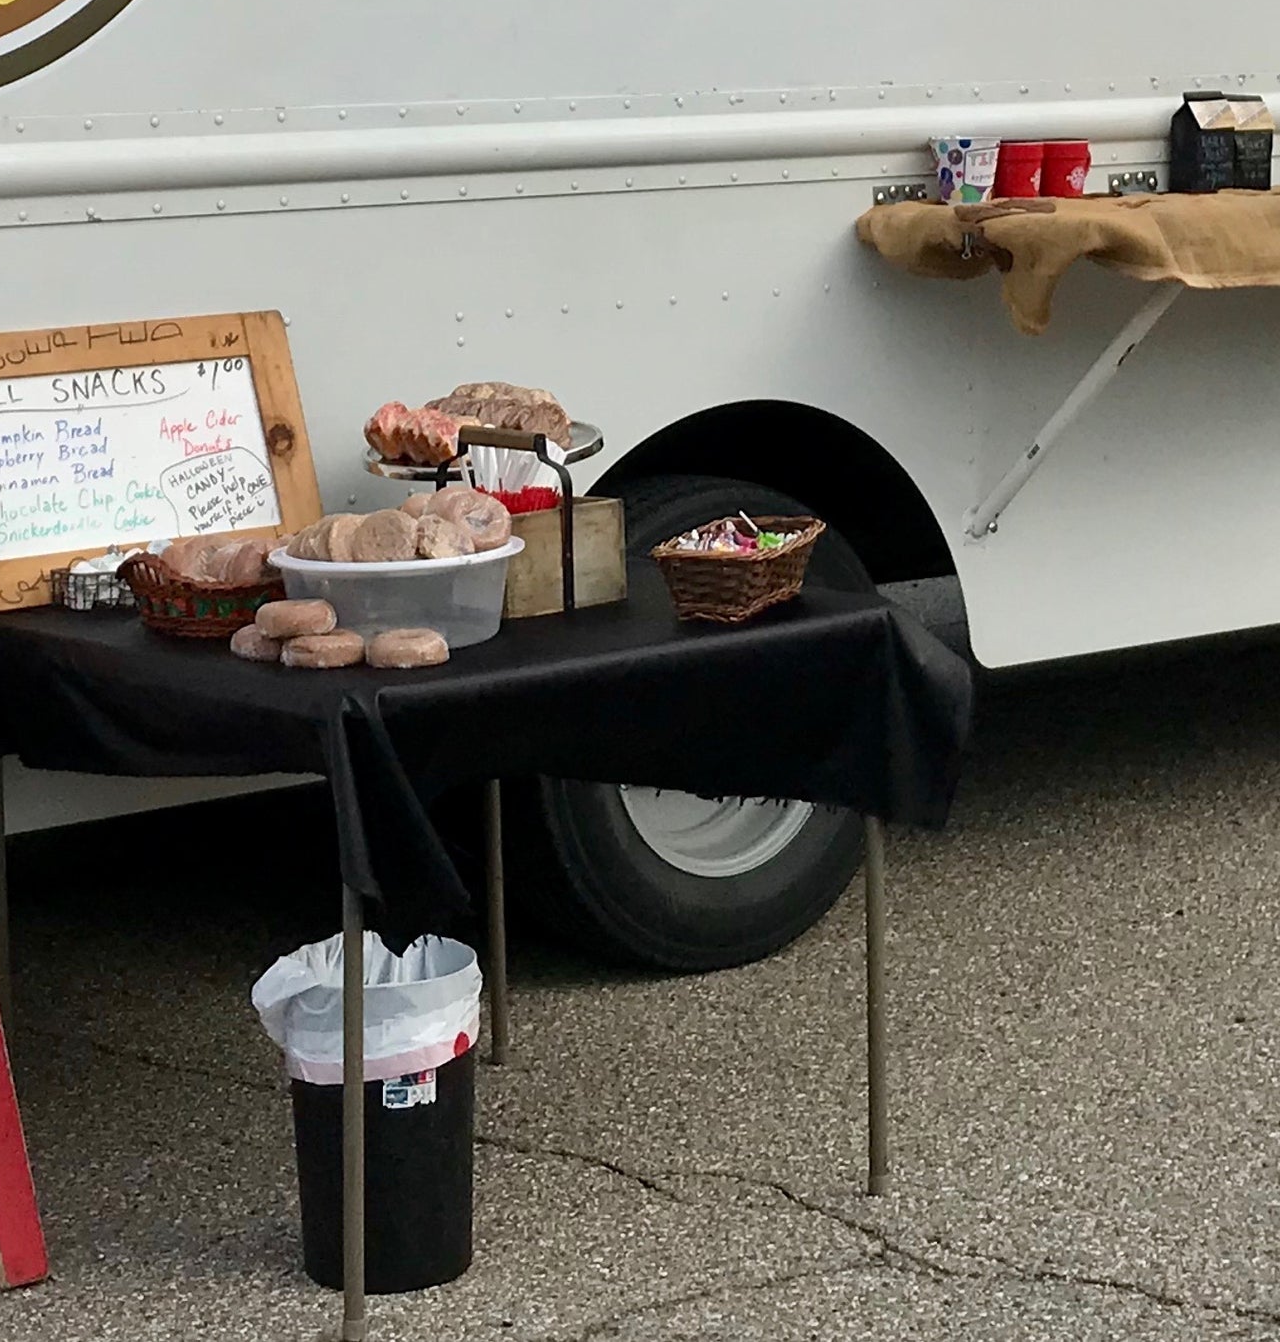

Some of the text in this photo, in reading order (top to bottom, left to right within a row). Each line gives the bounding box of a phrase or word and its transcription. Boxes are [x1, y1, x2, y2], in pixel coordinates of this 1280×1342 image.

[53, 368, 167, 404] SNACKS
[54, 417, 103, 442] Bread
[159, 409, 243, 445] Apple Cider
[58, 436, 108, 461] Bread
[182, 434, 233, 458] Donuts
[70, 457, 116, 484] Bread
[168, 453, 234, 489] HALLOWEEN
[77, 487, 115, 513] Chip
[125, 479, 164, 504] Cookie
[188, 475, 246, 521] Please help
[235, 492, 246, 506] to
[246, 475, 268, 496] ONE
[113, 507, 157, 532] Cookie
[228, 504, 256, 530] piece
